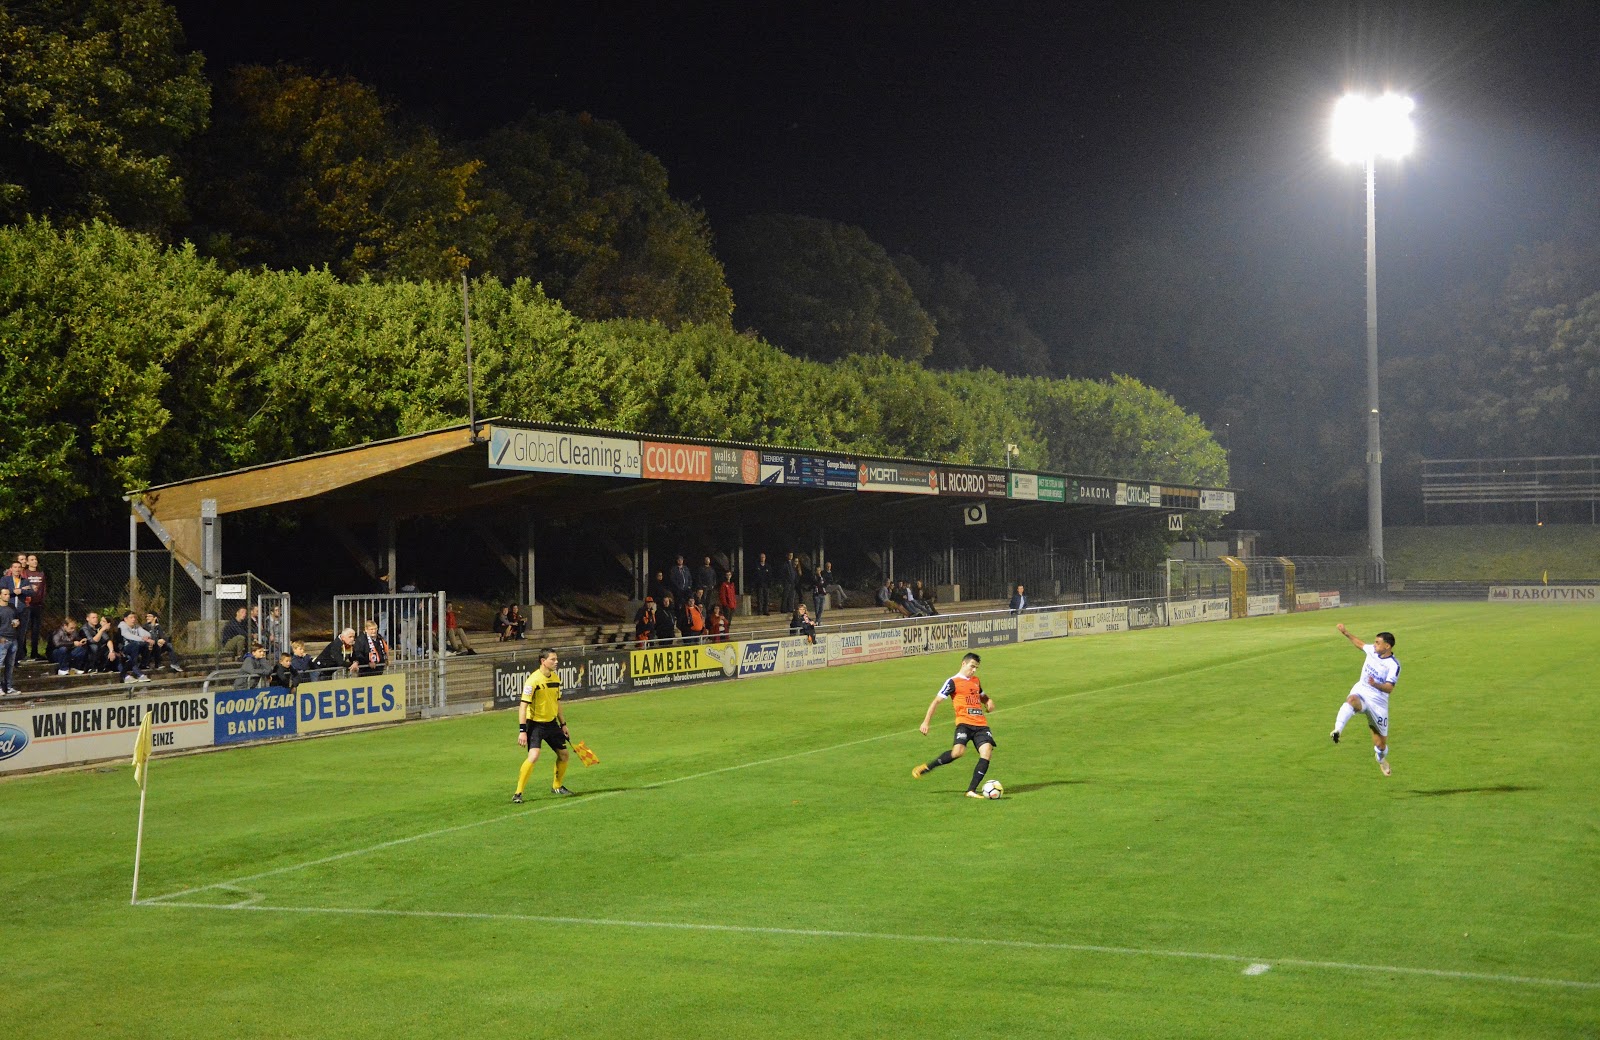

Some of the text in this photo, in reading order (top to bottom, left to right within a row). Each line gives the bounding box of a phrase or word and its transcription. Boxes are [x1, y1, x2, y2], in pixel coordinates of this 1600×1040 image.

[646, 447, 707, 475] COLOVIT
[714, 450, 736, 462] walls &
[714, 462, 738, 478] ceilings
[870, 467, 898, 481] MORTI
[940, 472, 985, 493] IL RICORDO
[1081, 486, 1110, 498] DAKOTA
[1170, 517, 1181, 528] M
[1512, 588, 1595, 599] RABOTVINS
[931, 623, 967, 640] KOUTERKE
[841, 635, 862, 647] TAVATI
[634, 649, 698, 675] LAMBERT
[496, 666, 530, 701] Fregiri
[300, 684, 395, 722] DEBELS
[32, 698, 208, 738] VAN DEN POEL MOTORS
[228, 716, 285, 735] BANDEN
[1377, 716, 1387, 727] 20
[152, 731, 174, 747] EINZE
